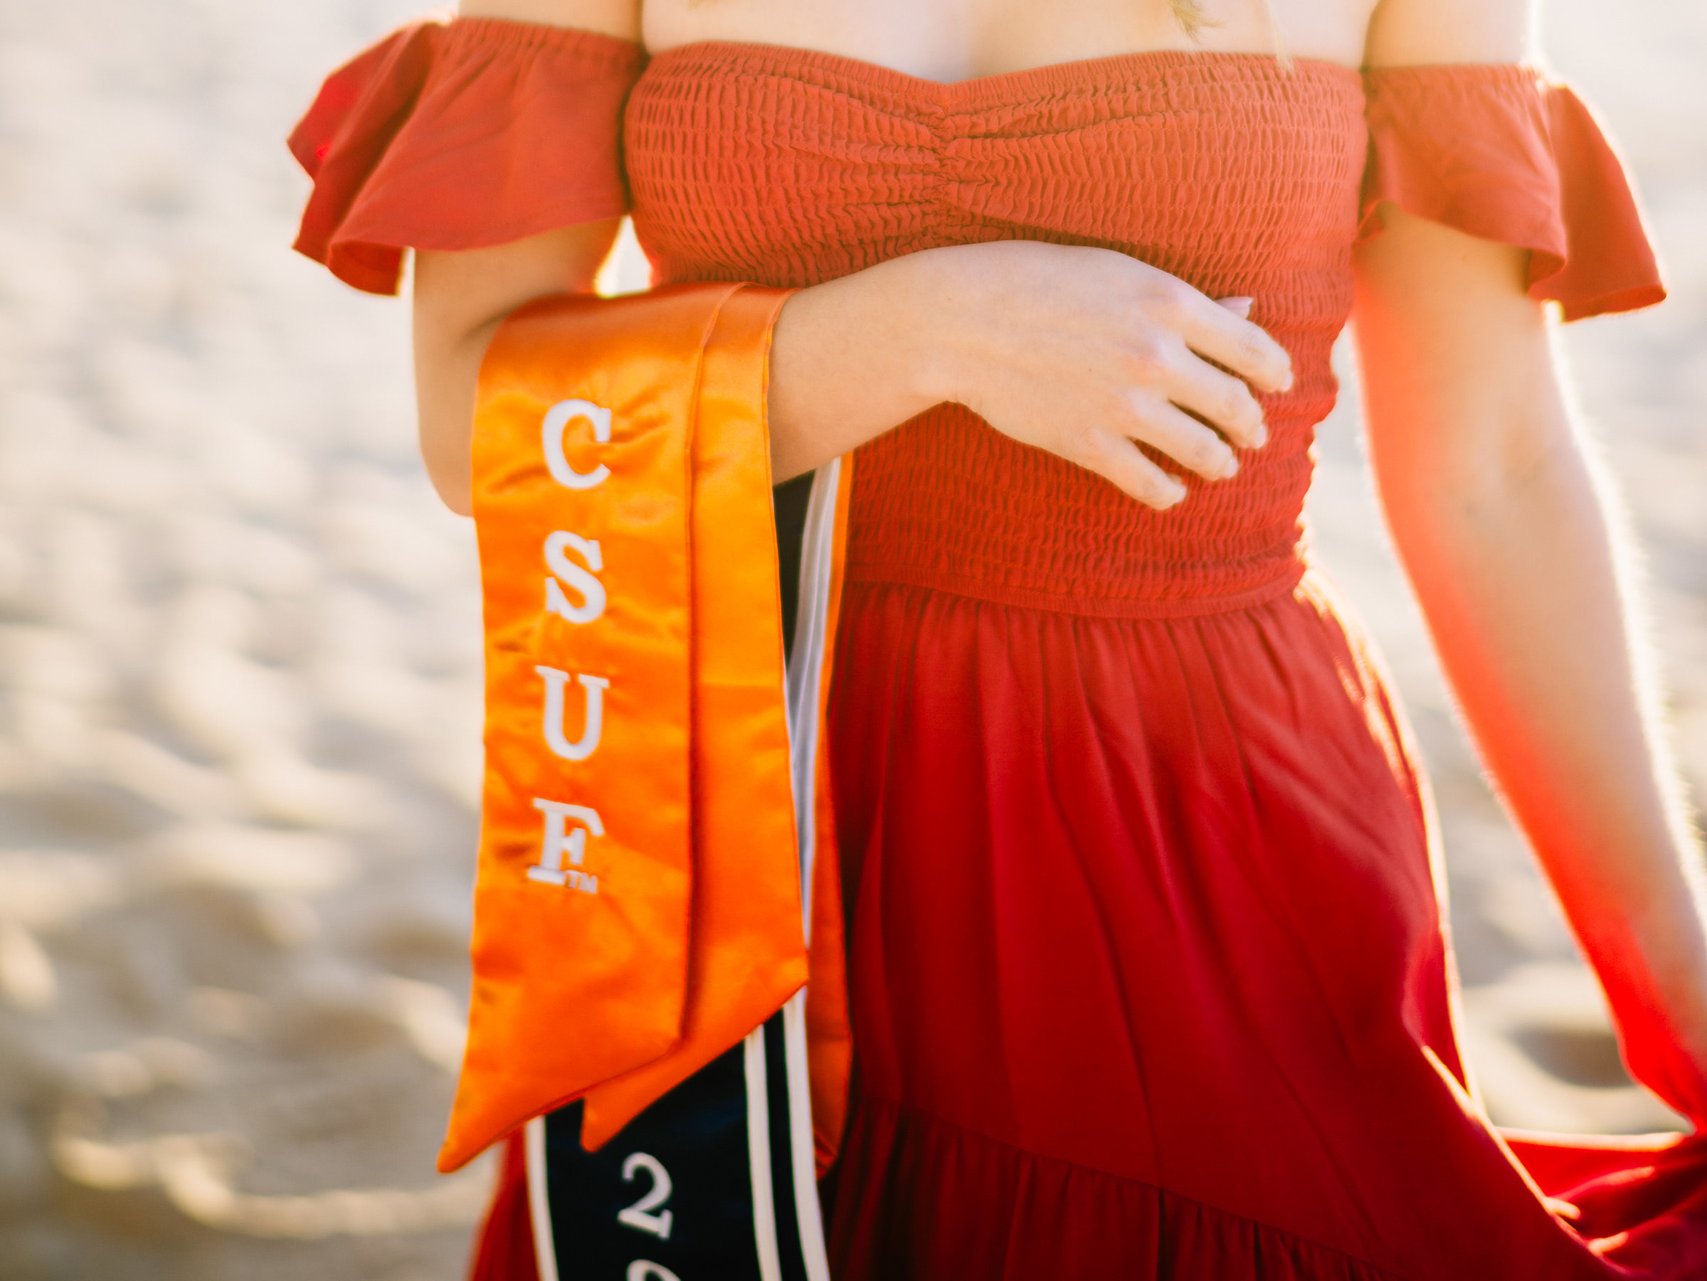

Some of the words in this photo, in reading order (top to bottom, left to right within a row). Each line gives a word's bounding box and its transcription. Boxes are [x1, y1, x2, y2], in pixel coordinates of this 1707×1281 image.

[527, 398, 612, 885] CSUF
[564, 869, 598, 895] TM
[617, 1151, 682, 1281] 2
